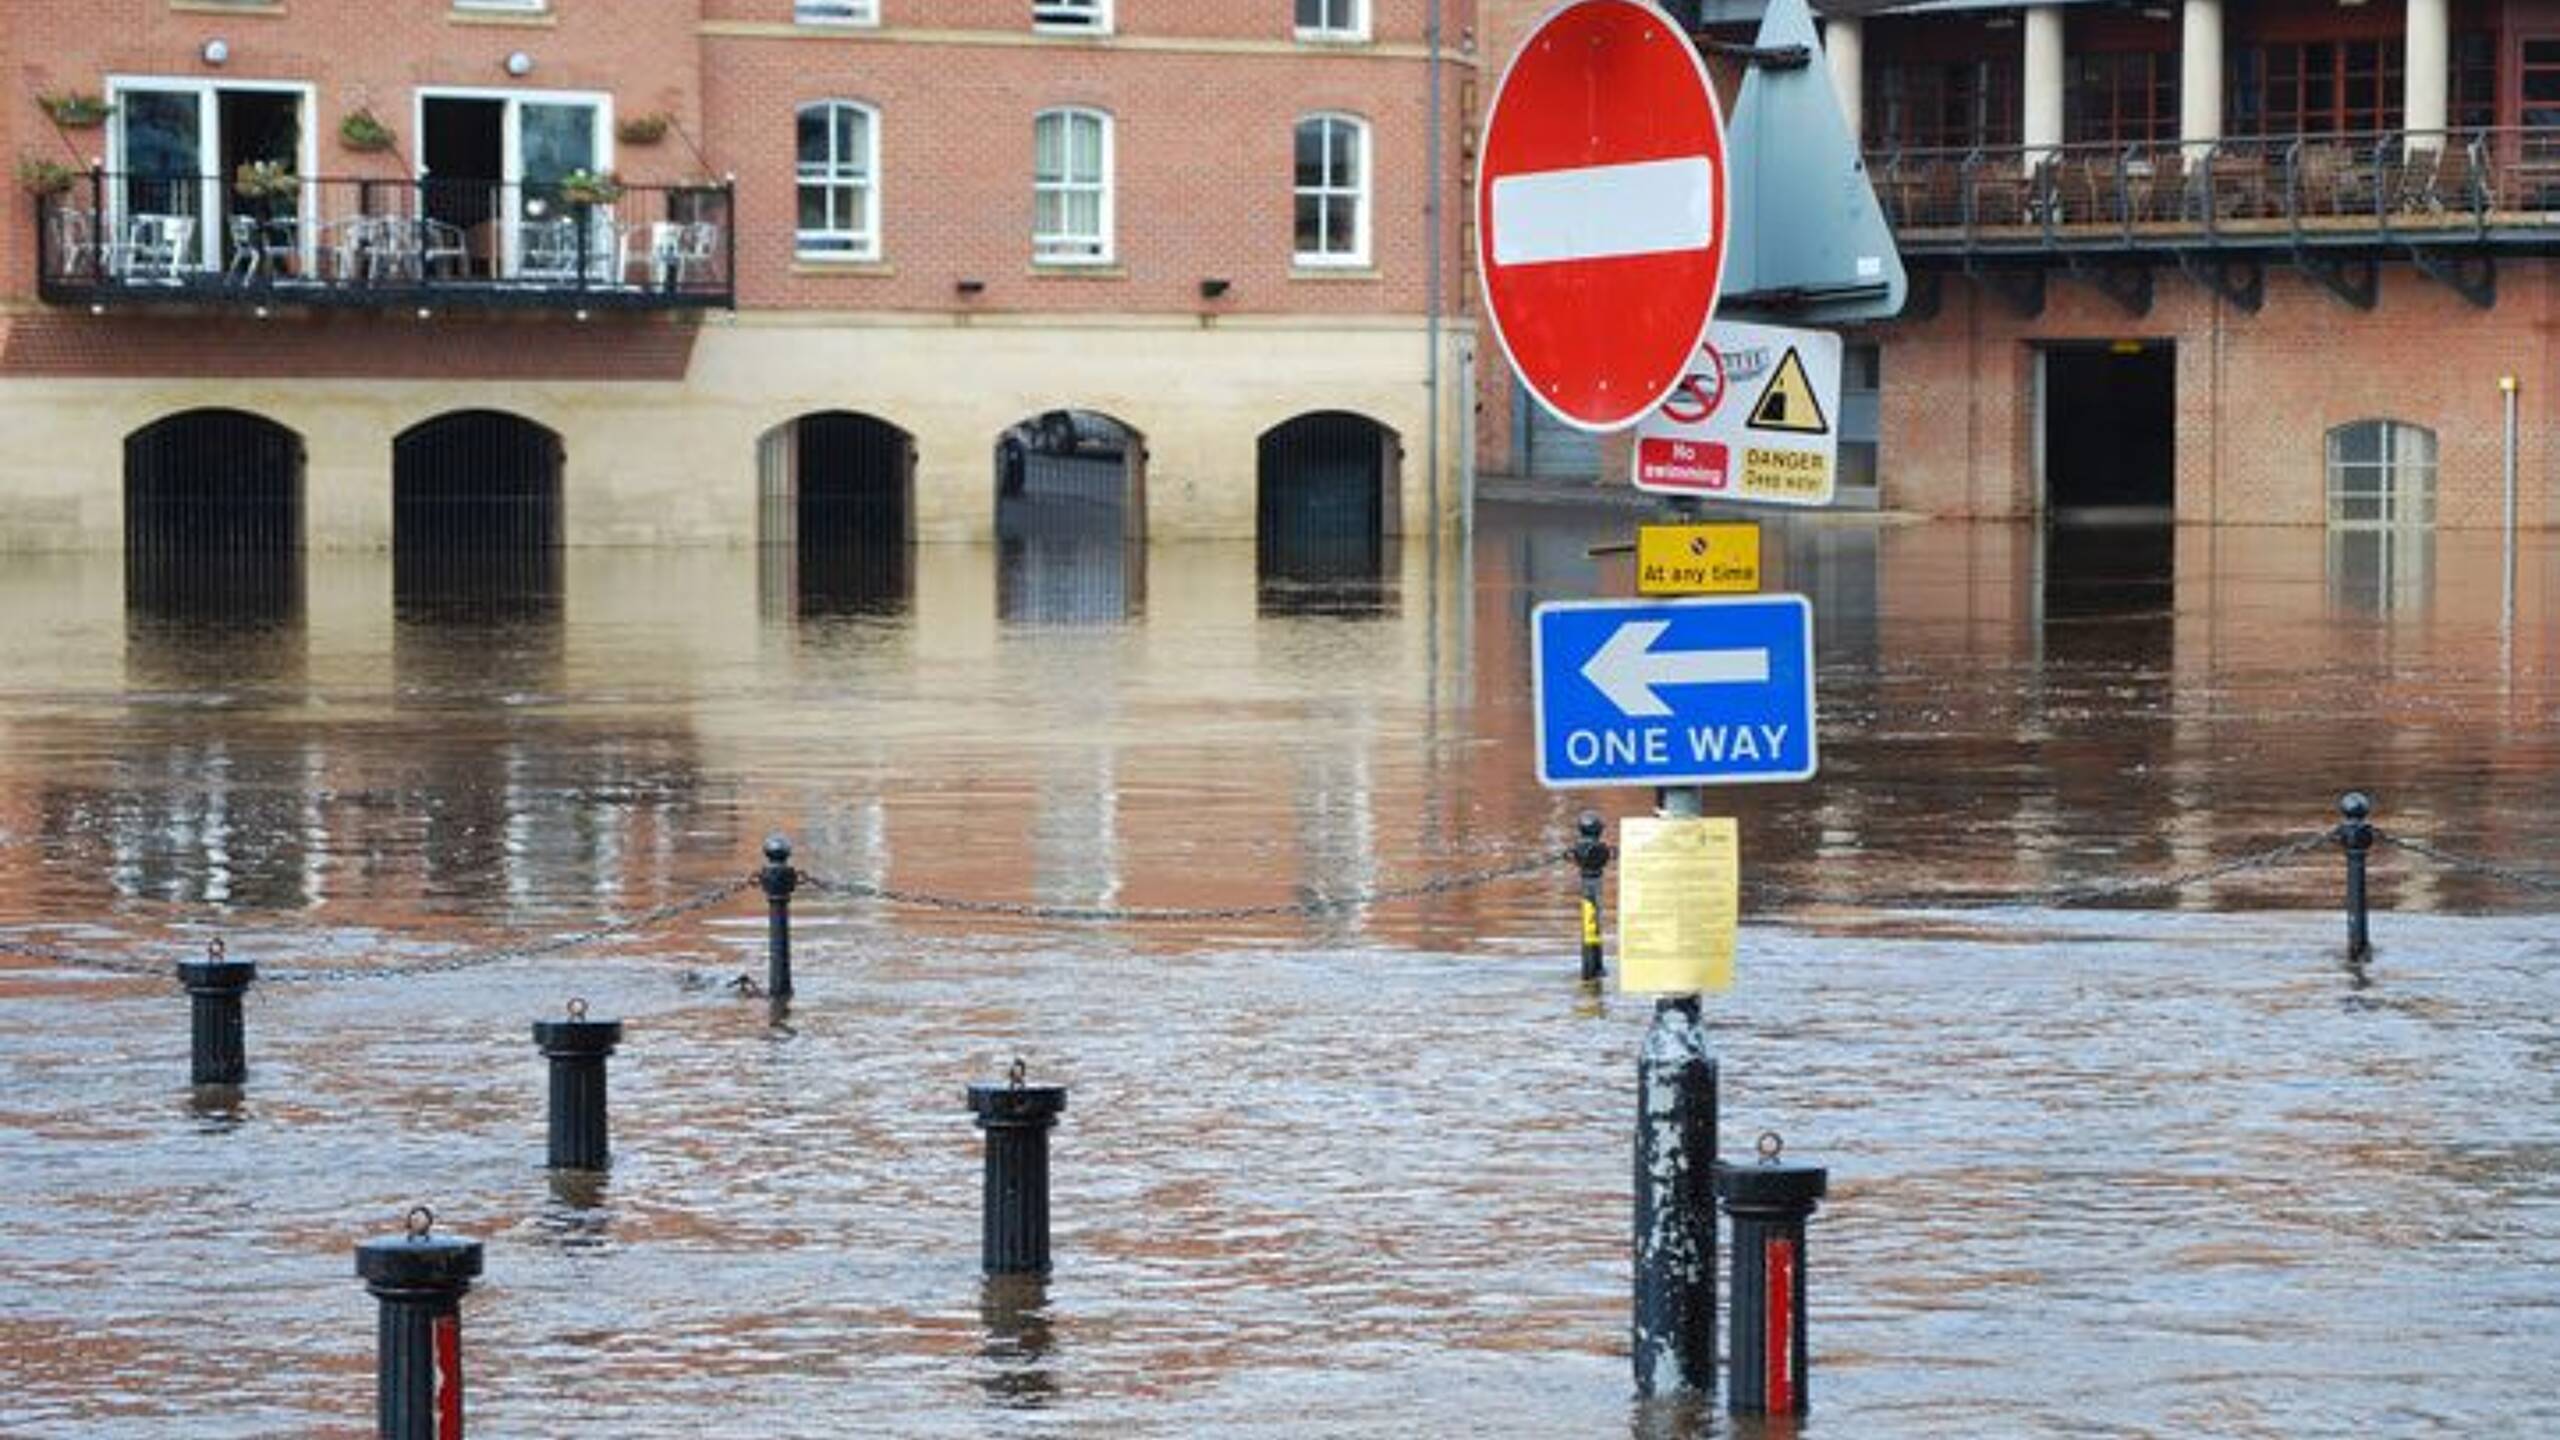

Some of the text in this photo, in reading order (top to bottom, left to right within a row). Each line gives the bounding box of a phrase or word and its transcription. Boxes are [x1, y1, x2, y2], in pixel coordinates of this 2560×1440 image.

[1673, 442, 1697, 460] No
[1747, 449, 1823, 470] DANGER
[1645, 464, 1721, 486] swimming
[1644, 564, 1754, 585] At any time
[1567, 724, 1788, 765] ONE WAY
